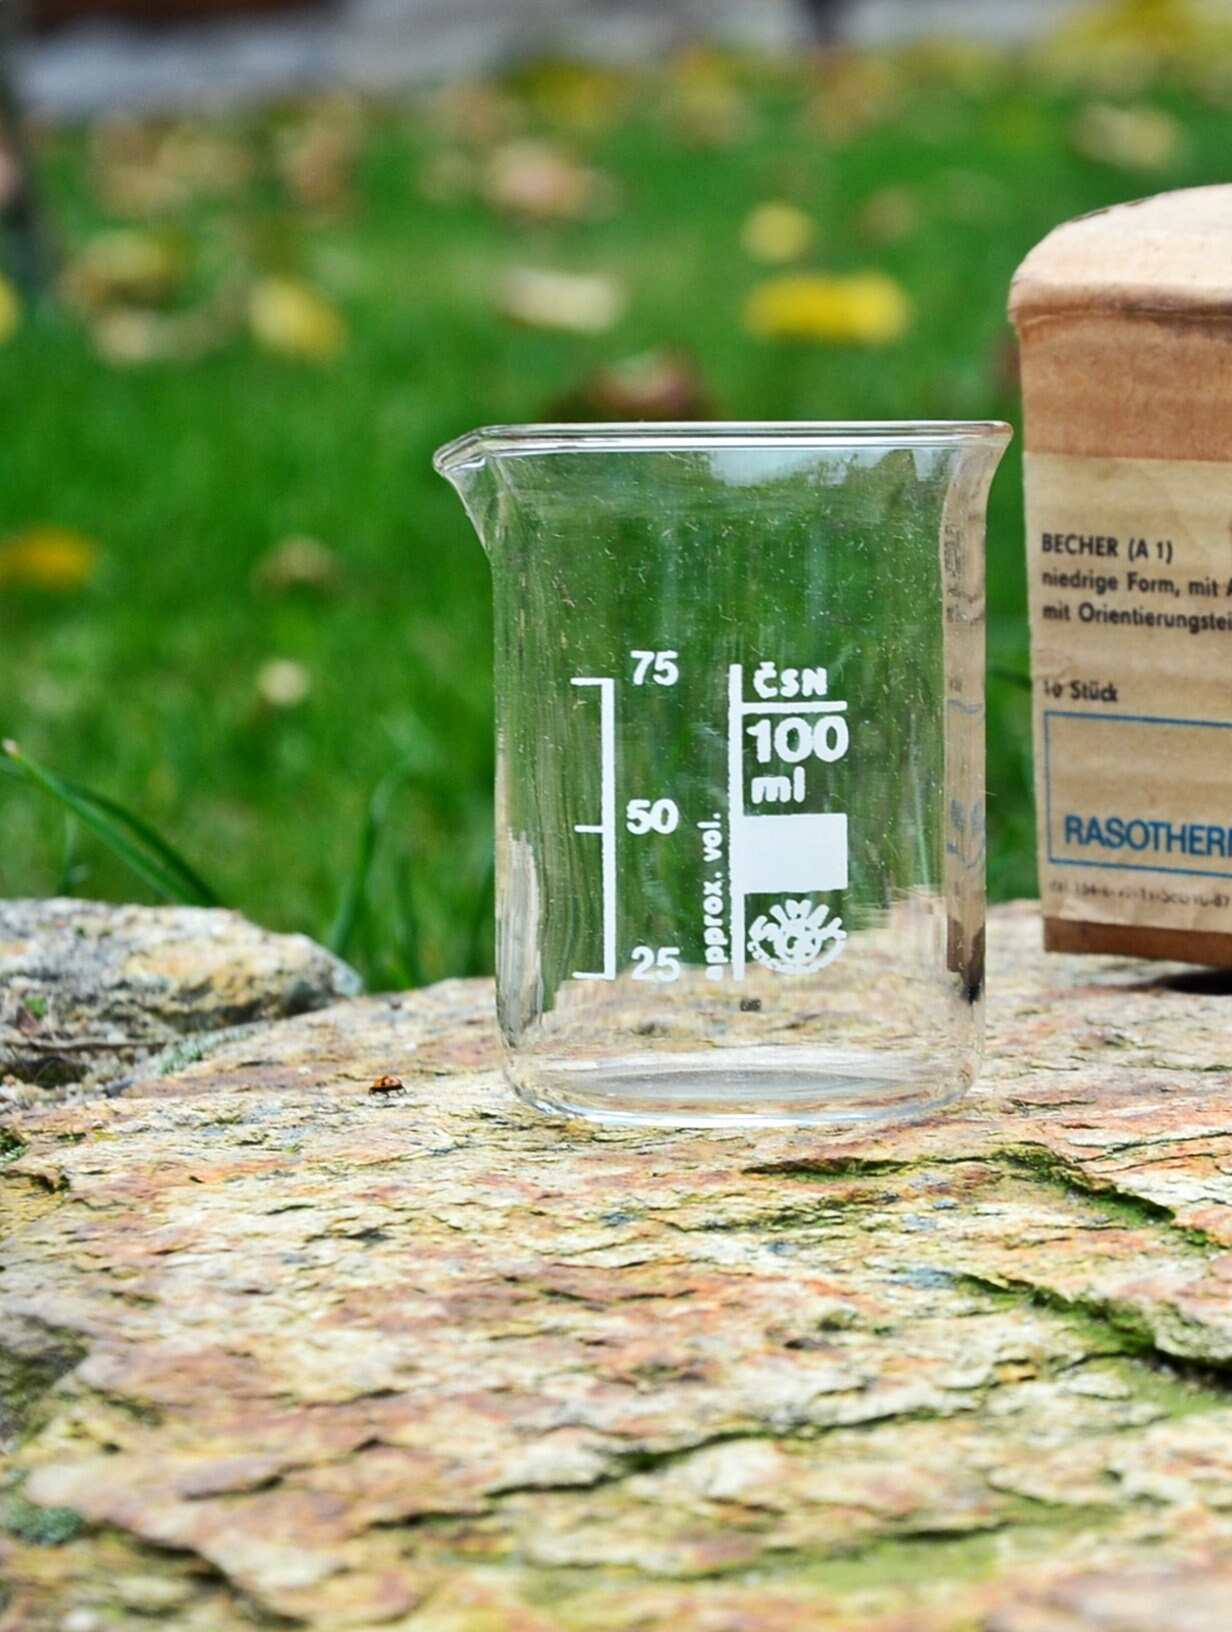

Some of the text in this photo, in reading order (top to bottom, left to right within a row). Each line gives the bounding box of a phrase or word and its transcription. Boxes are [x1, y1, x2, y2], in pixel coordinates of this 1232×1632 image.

[1041, 533, 1173, 564] BECHER (A 1)
[1042, 568, 1118, 595] niedrige
[1127, 572, 1180, 597] Form,
[1189, 577, 1218, 597] mit
[1043, 603, 1071, 622] mit
[630, 650, 679, 685] 75
[753, 661, 828, 698] ČSN
[1070, 679, 1118, 702] Stück
[746, 715, 850, 763] 100
[751, 766, 805, 804] ml
[626, 799, 679, 834] 50
[697, 813, 729, 981] approx. vol.
[630, 946, 681, 982] 25
